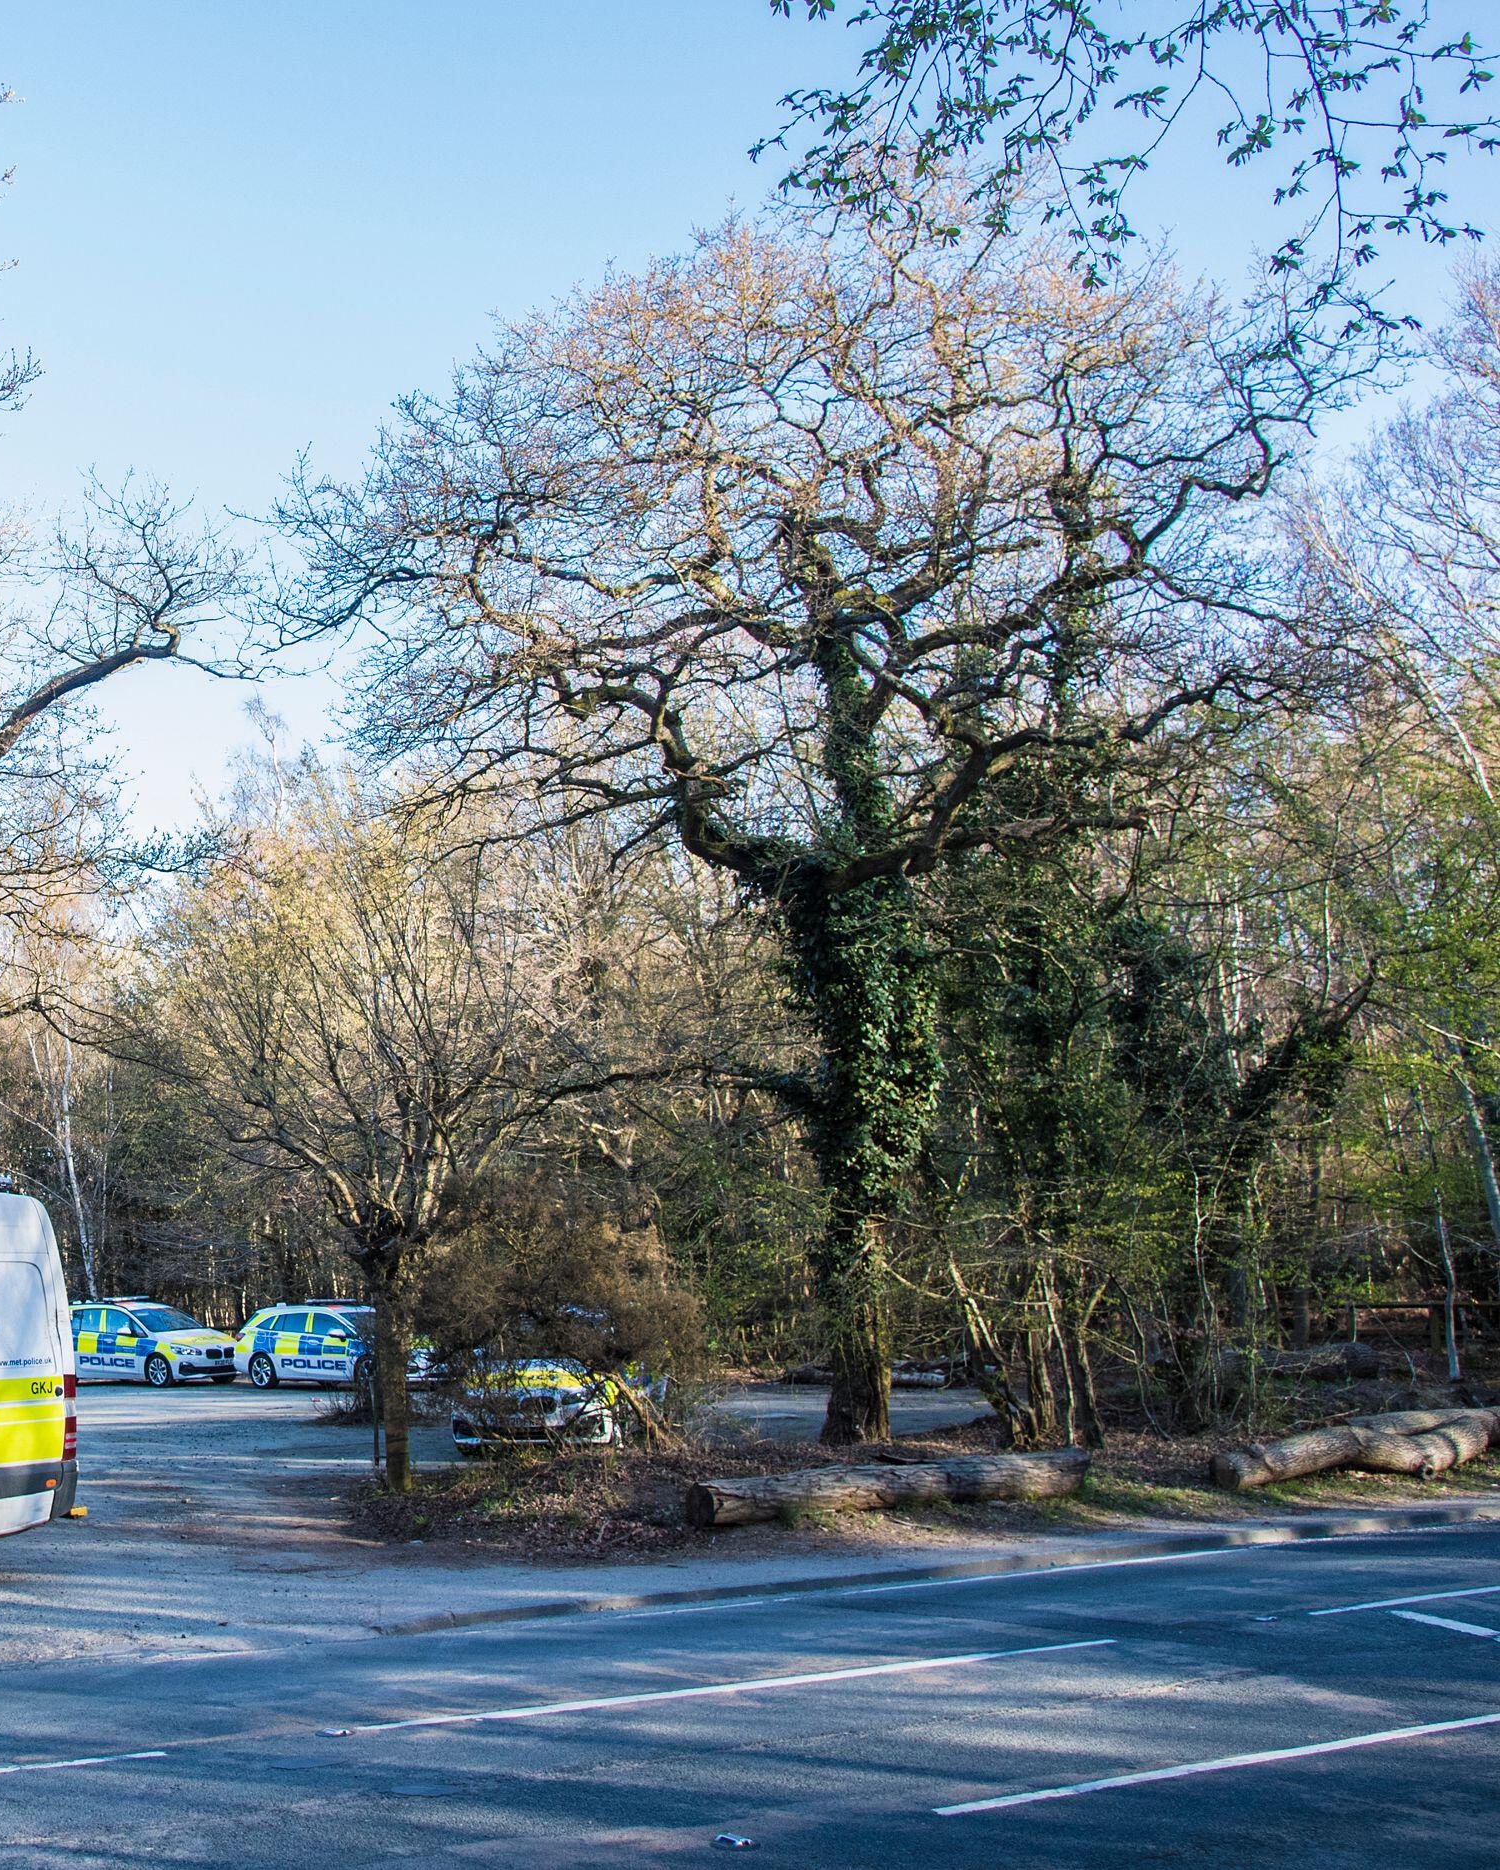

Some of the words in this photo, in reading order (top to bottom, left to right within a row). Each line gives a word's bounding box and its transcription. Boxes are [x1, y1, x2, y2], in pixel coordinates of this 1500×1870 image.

[79, 1356, 135, 1368] POLICE
[281, 1358, 346, 1370] POLICE
[31, 1381, 53, 1394] GKJ
